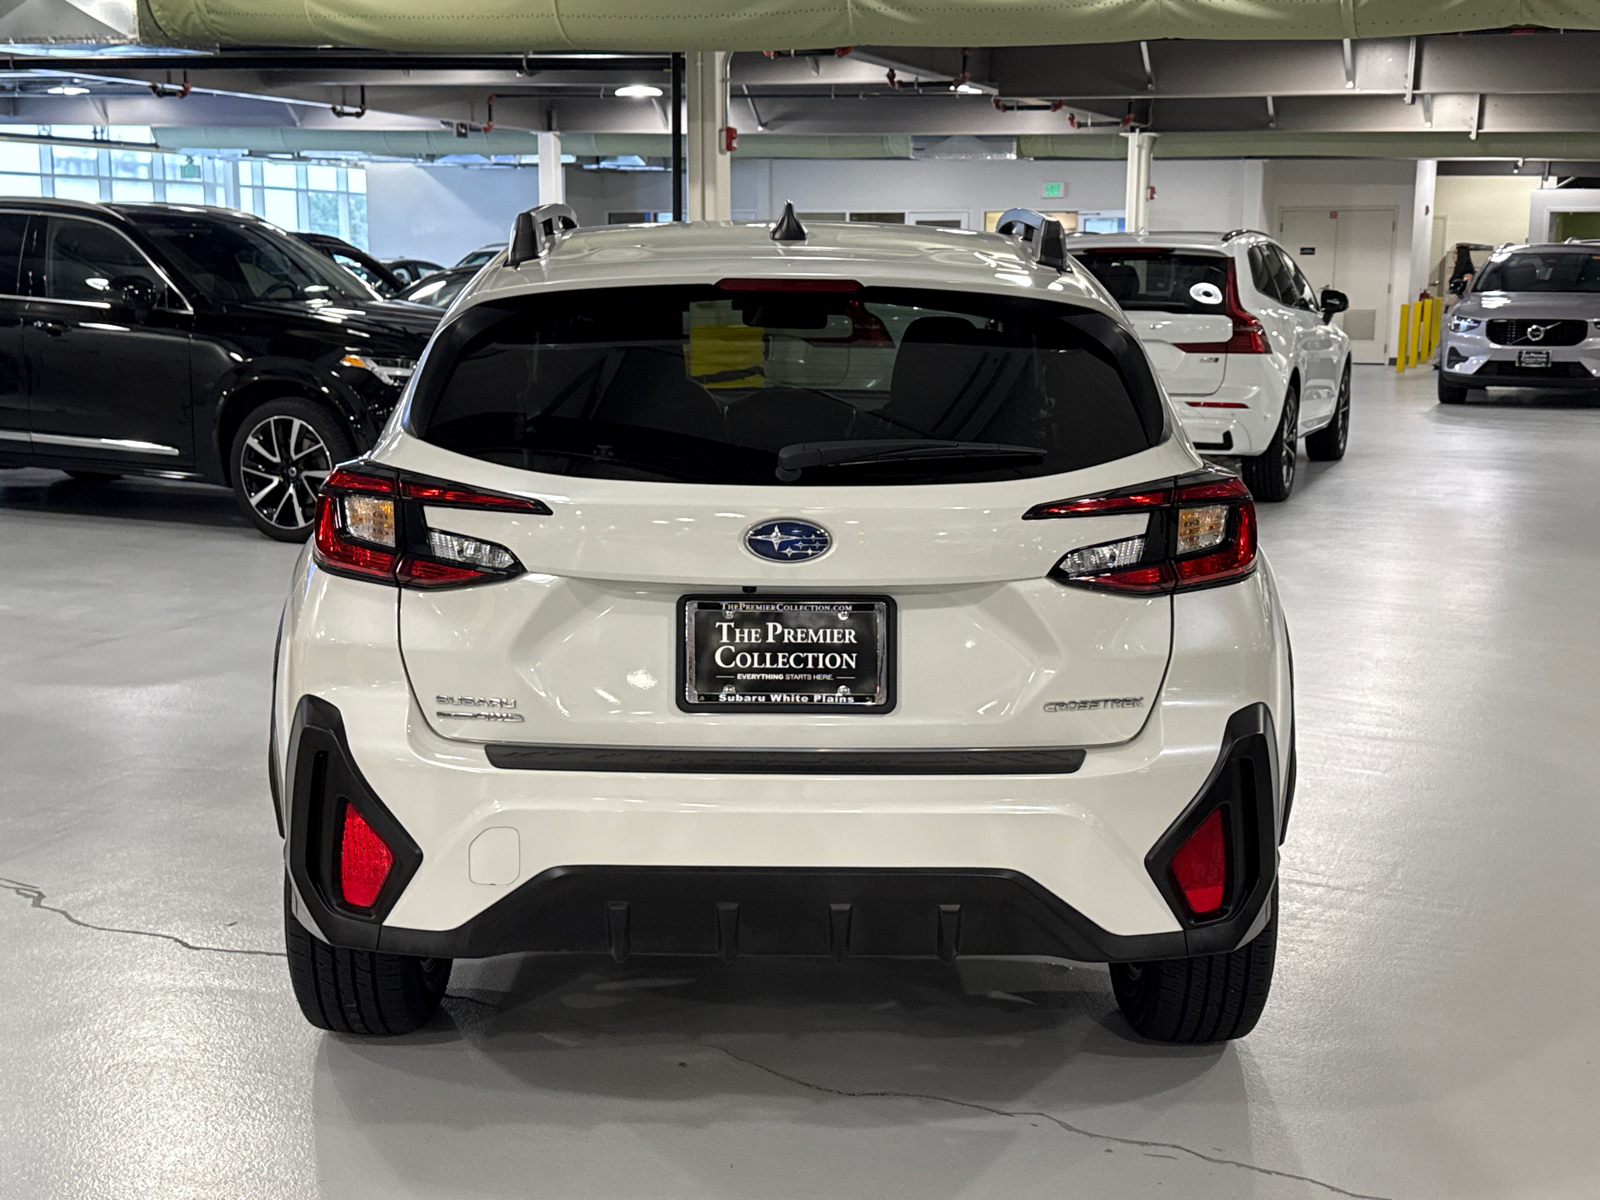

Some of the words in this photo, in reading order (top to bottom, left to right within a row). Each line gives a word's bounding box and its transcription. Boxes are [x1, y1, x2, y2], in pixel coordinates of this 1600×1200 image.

[715, 621, 761, 643] THE
[766, 621, 857, 644] PREMIER
[714, 645, 857, 669] COLLECTION
[785, 673, 812, 681] STARTS
[436, 694, 517, 708] SUBARU
[718, 693, 766, 702] Subaru
[770, 693, 809, 703] White
[813, 694, 855, 704] Plains
[1043, 697, 1144, 712] CROSSTREK
